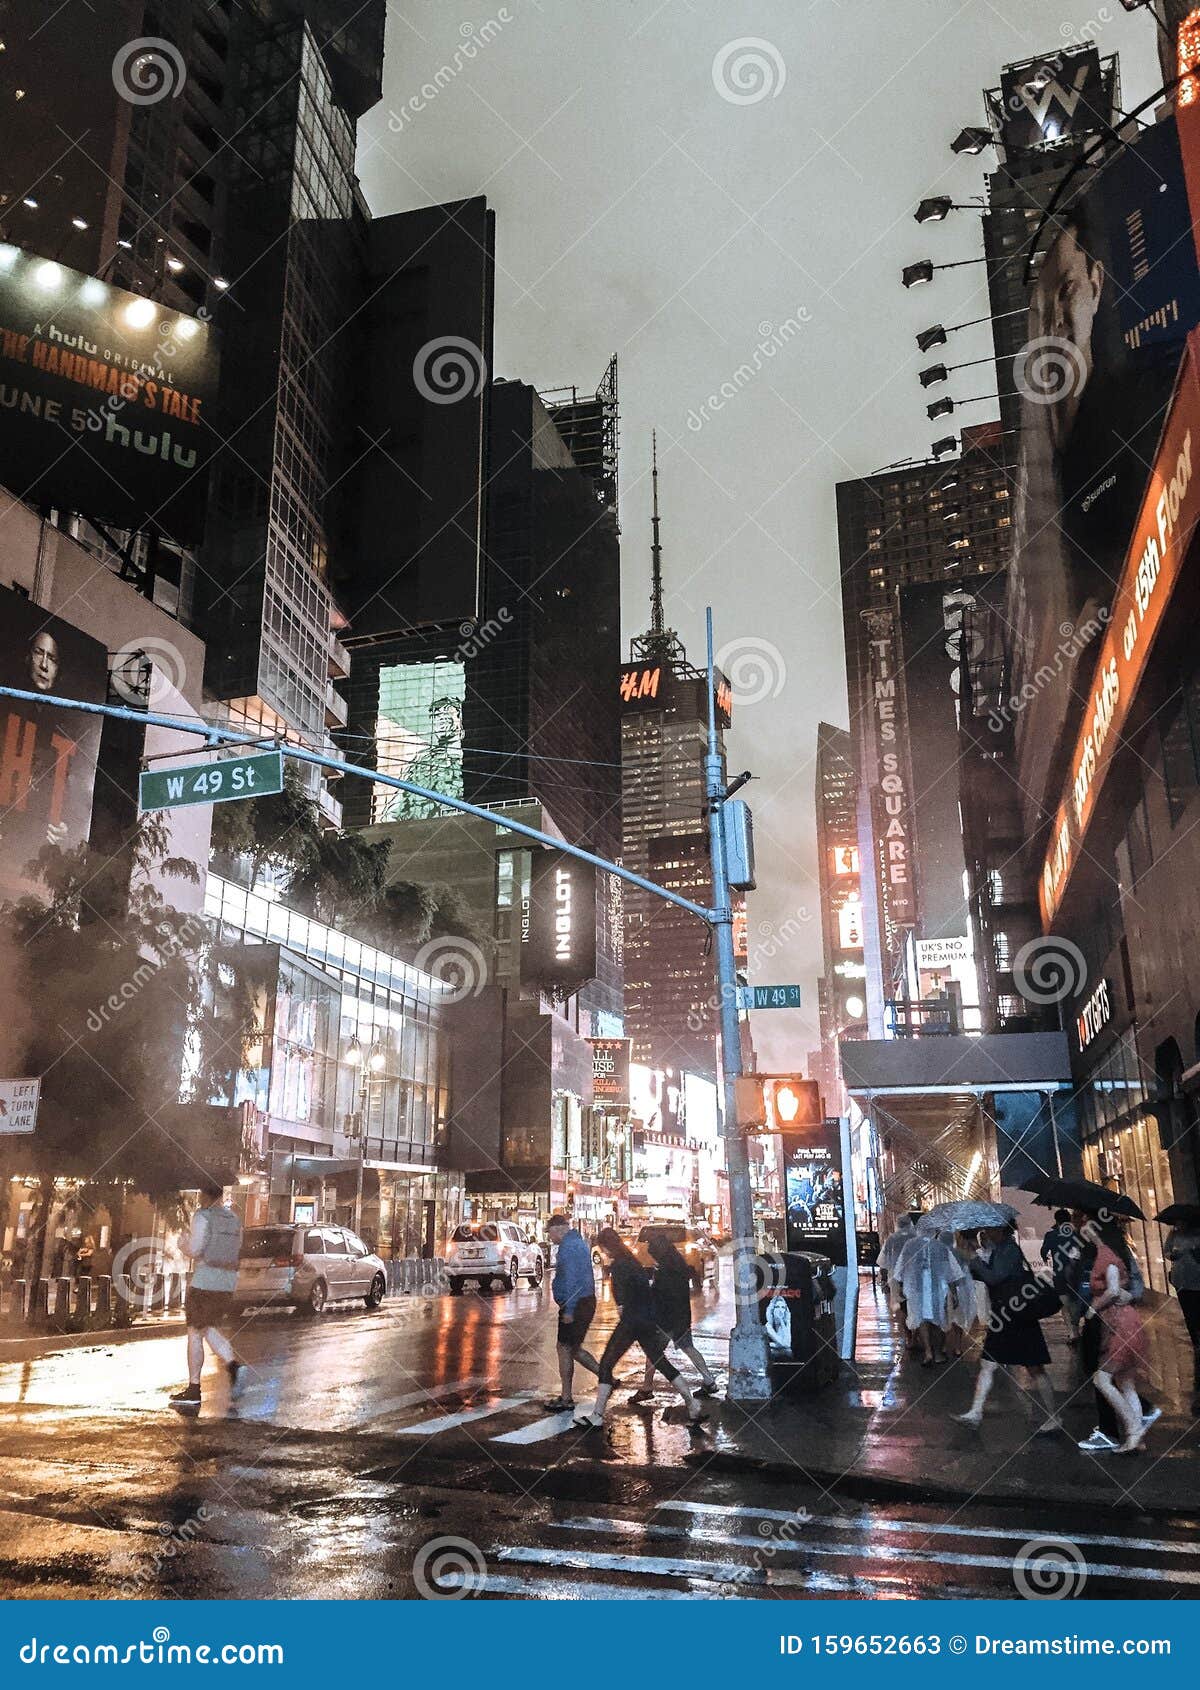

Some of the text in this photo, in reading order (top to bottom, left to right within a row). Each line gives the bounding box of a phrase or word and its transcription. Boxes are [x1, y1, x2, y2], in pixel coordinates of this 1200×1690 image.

[0, 327, 28, 364] HE
[162, 386, 202, 426] TALE
[48, 324, 97, 354] hulu
[103, 349, 174, 384] ORIGINAL
[0, 384, 86, 432] UNE 5
[105, 412, 197, 469] hulu
[1155, 427, 1193, 557] Floor
[870, 640, 896, 741] TIMES
[166, 766, 256, 800] W 49 St
[881, 753, 908, 885] SQUARE
[555, 869, 571, 960] INGLOT
[921, 941, 963, 952] UK'S NO
[922, 952, 968, 962] PREMIUM
[756, 988, 799, 1006] W 49 St
[11, 1100, 34, 1113] TURN
[13, 1085, 35, 1097] LEFT
[9, 1114, 31, 1127] LANE
